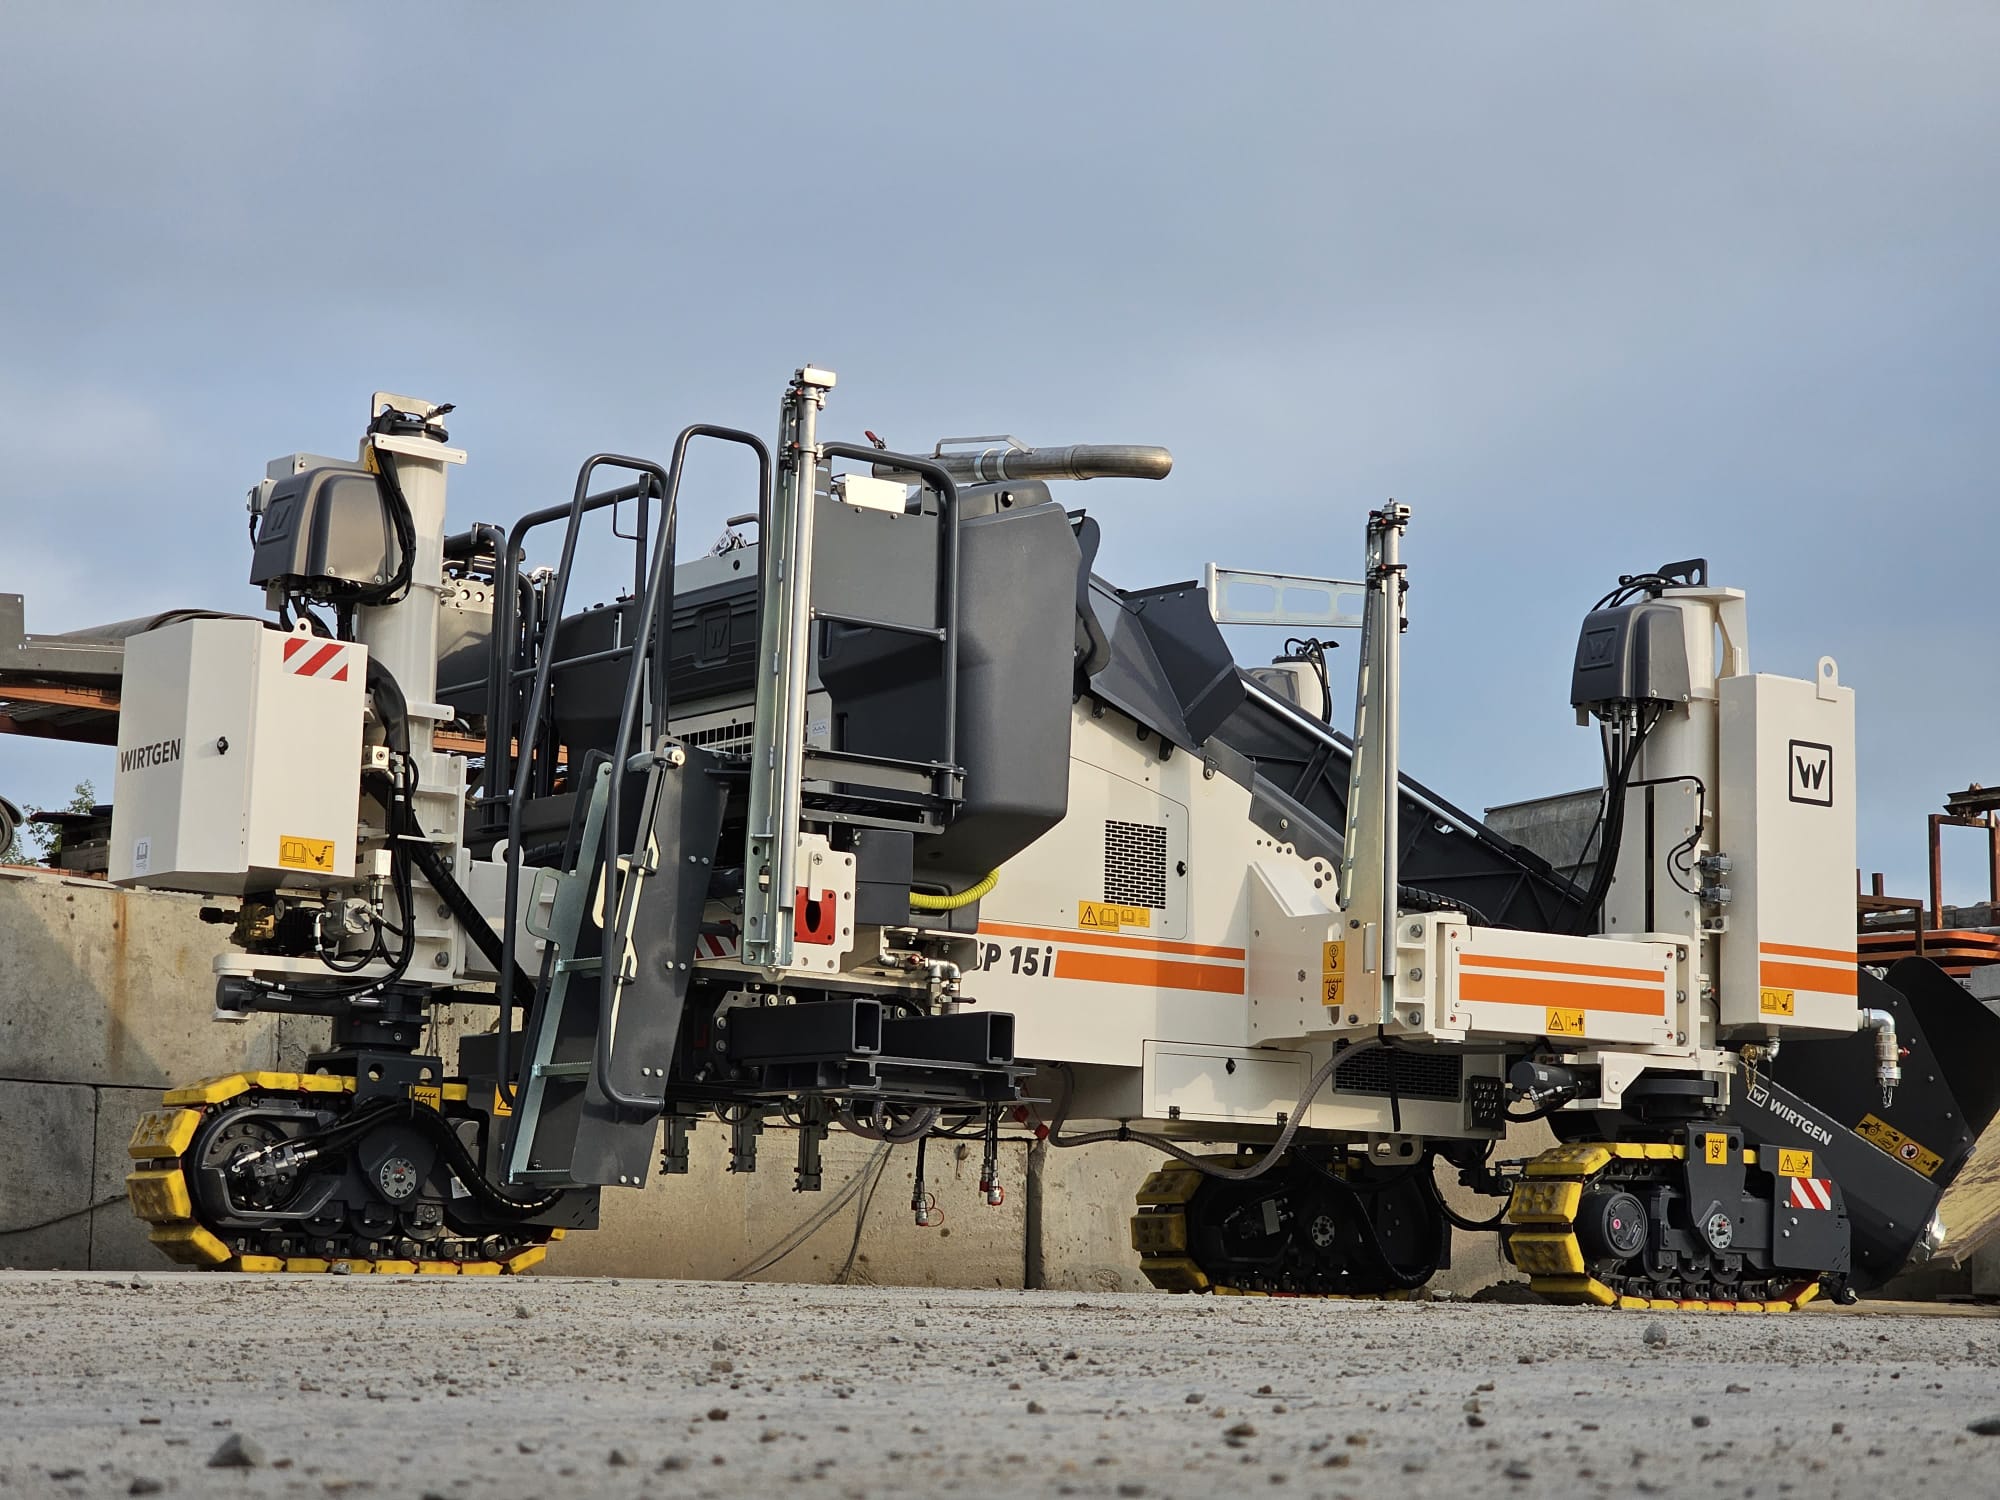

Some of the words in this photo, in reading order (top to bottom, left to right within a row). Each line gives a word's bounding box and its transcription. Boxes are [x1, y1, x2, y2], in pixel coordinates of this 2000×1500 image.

[121, 738, 181, 773] WIRTGEN
[1795, 755, 1827, 790] W
[1769, 1098, 1833, 1146] WIRTGEN
